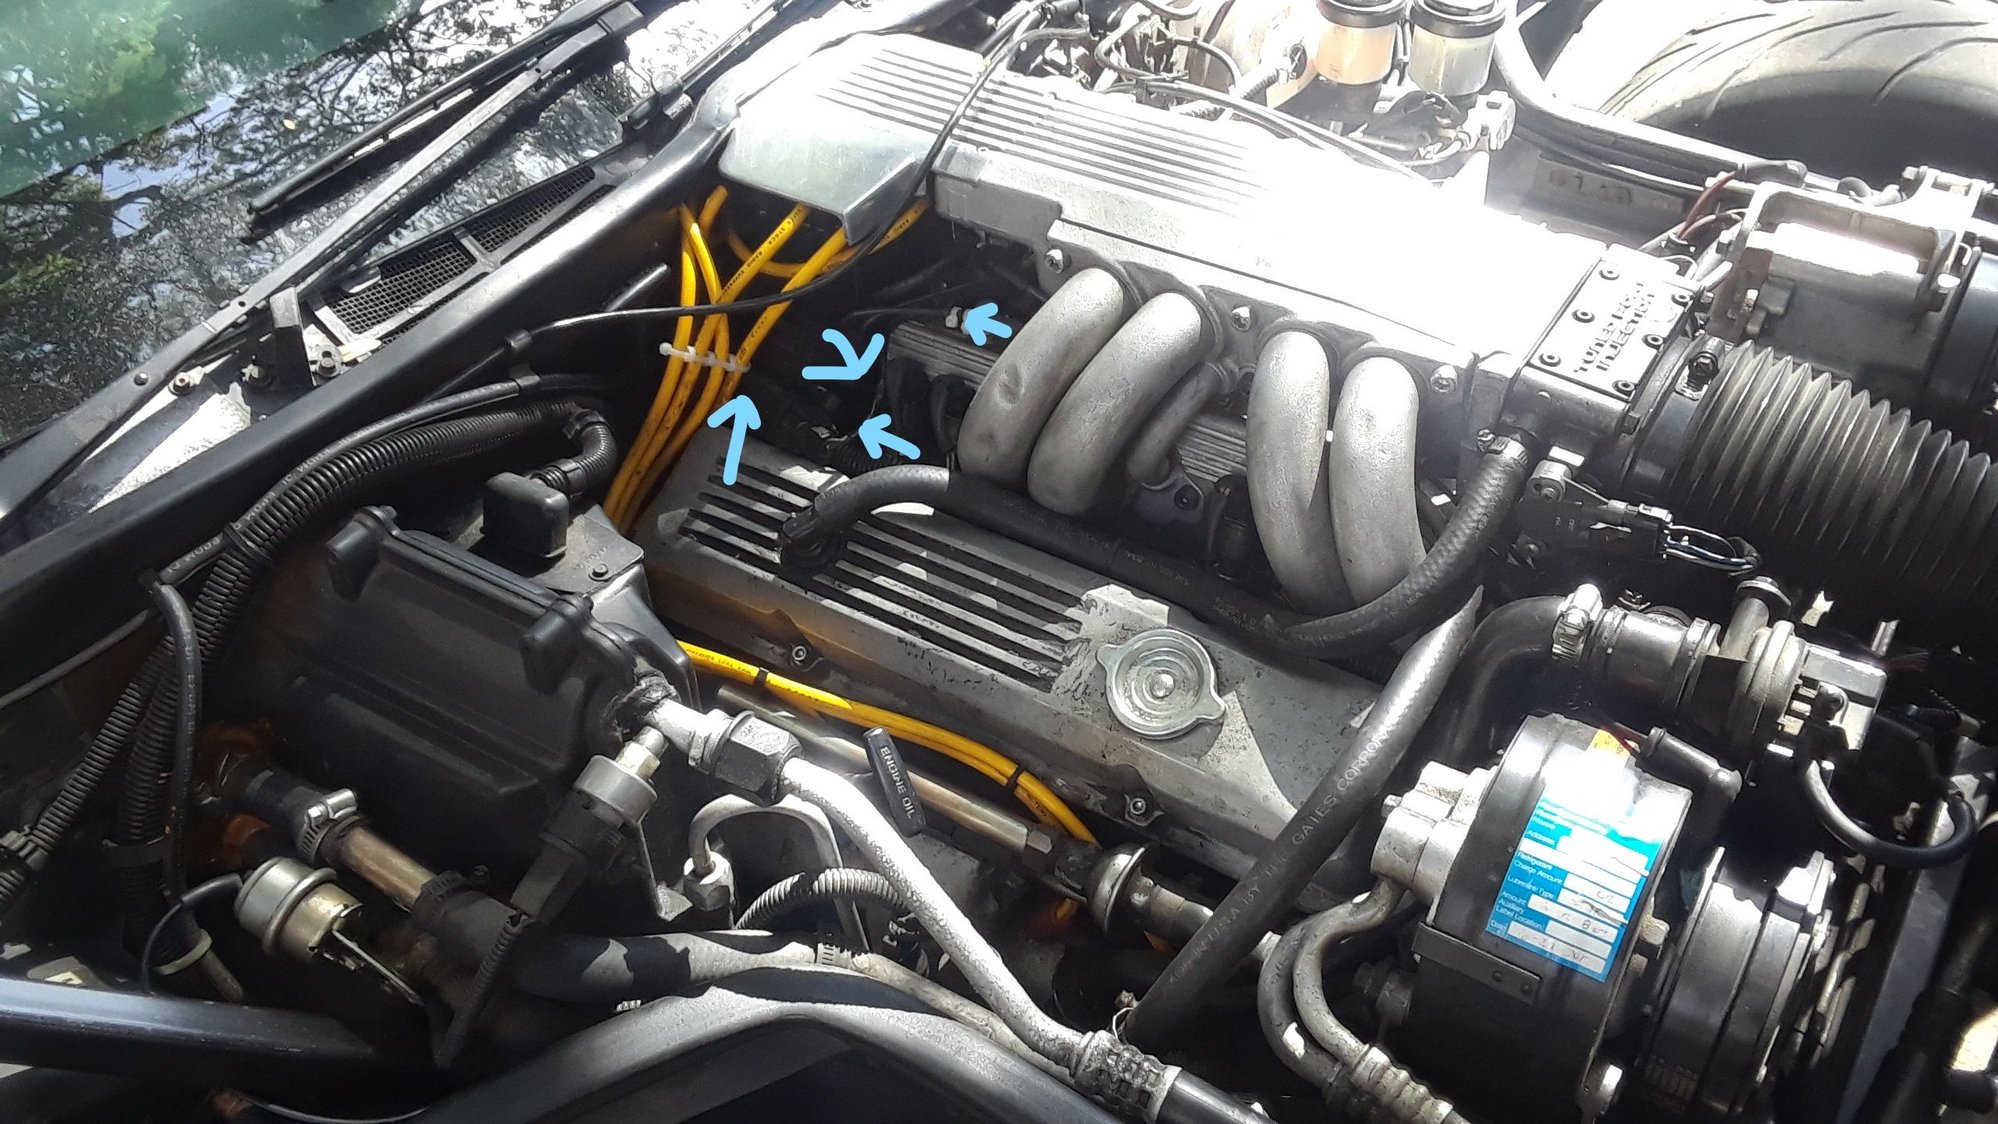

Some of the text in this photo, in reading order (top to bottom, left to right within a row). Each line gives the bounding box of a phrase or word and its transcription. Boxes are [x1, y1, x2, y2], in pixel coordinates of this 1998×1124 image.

[1596, 294, 1656, 372] INJECTION
[880, 745, 916, 820] ENGINE OIL
[1291, 794, 1337, 845] GATES
